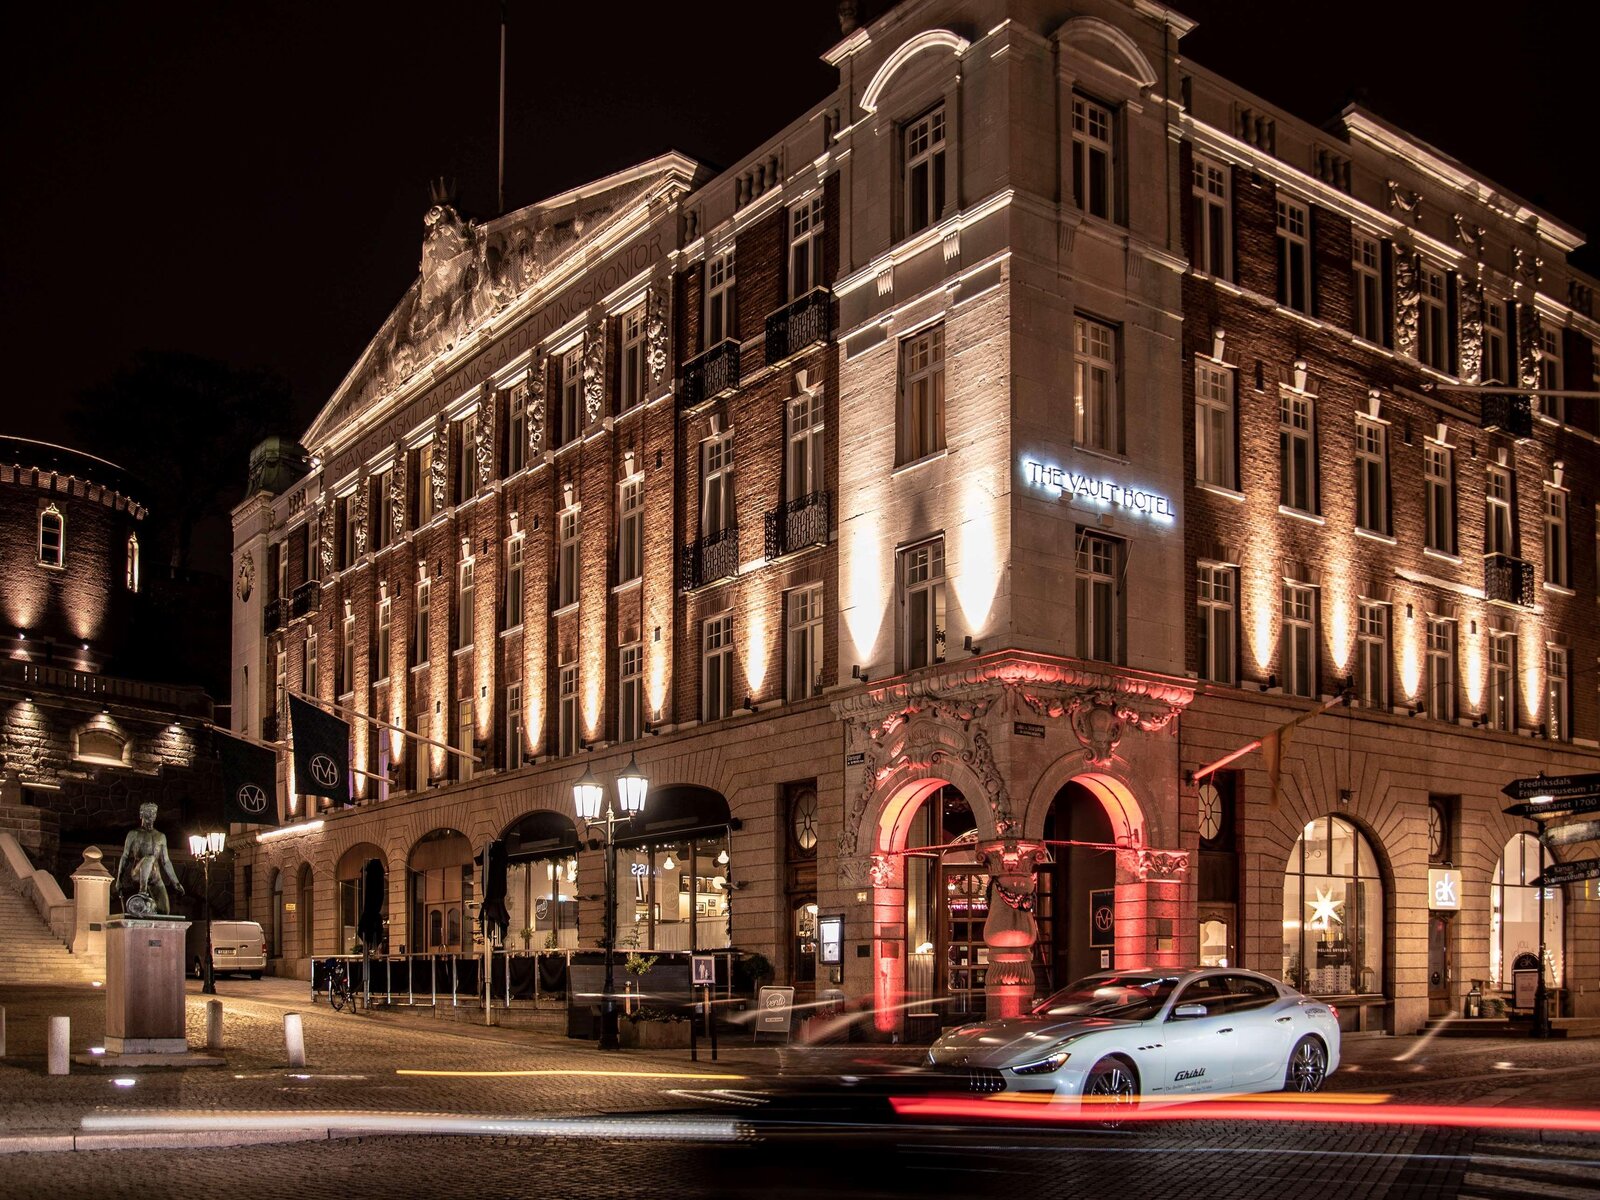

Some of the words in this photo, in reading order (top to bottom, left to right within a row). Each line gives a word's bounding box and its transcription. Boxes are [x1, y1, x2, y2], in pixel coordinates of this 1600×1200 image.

[443, 354, 492, 403] BANKS
[1028, 462, 1065, 488] THE
[1068, 471, 1120, 503] VAULT
[1123, 487, 1175, 517] HOTEL
[1518, 777, 1572, 788] Fredriksdals
[1518, 786, 1587, 798] Friluftsmuseum
[1524, 801, 1572, 813] Tropikariet
[1435, 873, 1456, 902] ak
[1174, 1067, 1207, 1082] Ghibli
